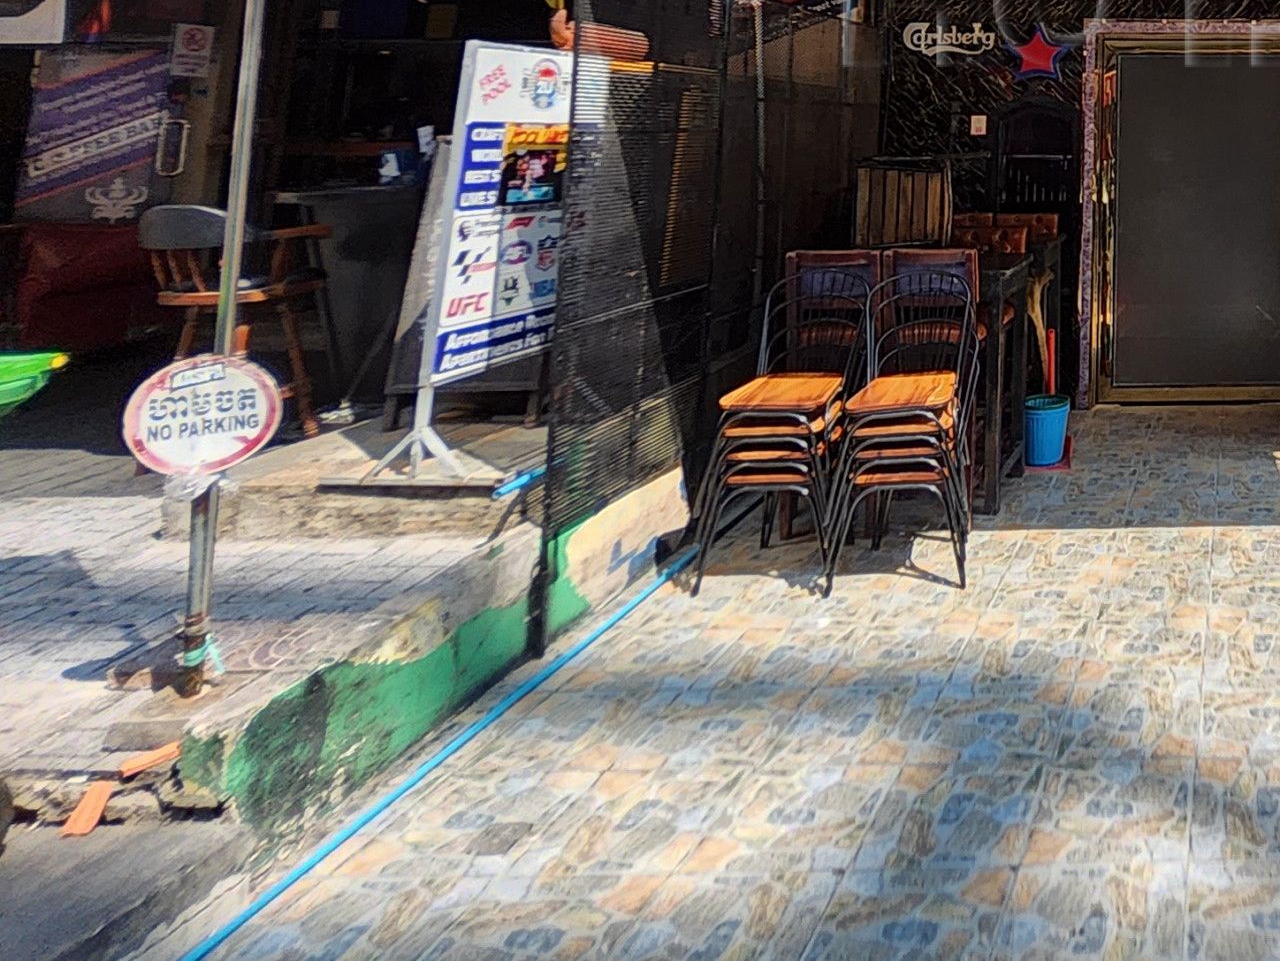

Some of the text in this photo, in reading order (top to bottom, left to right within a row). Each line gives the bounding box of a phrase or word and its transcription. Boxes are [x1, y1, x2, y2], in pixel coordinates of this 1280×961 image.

[903, 21, 996, 57] Carlsberg
[445, 291, 490, 319] UFC
[146, 413, 260, 443] NO PARKING
